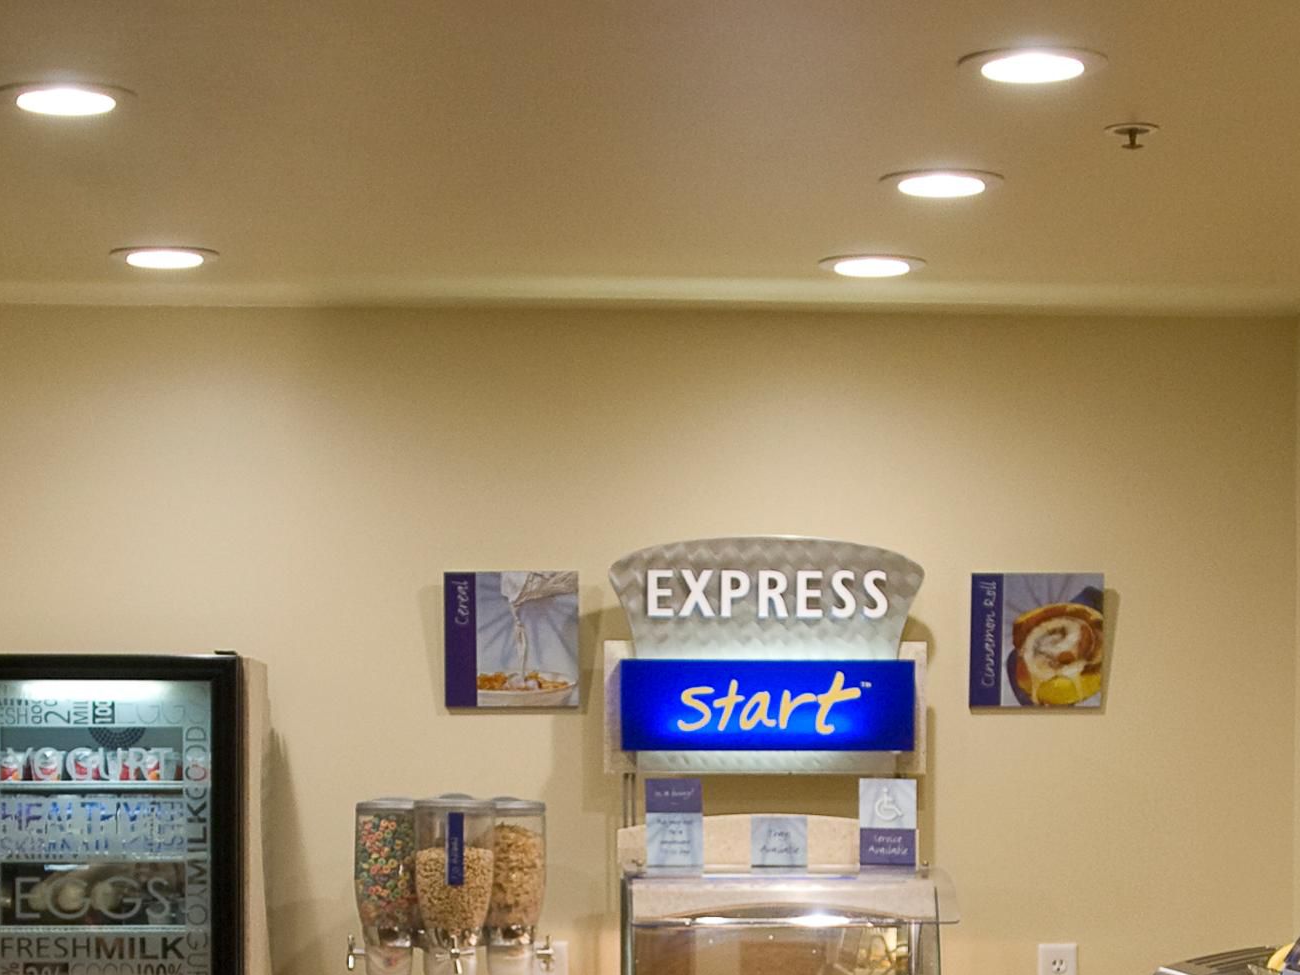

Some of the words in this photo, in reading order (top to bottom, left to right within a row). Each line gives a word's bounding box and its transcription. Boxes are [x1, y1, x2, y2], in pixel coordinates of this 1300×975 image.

[452, 580, 470, 625] Cereal
[646, 568, 890, 620] EXPRESS
[980, 581, 997, 607] Roll
[981, 611, 996, 687] Cinnamon
[677, 670, 862, 735] start
[4, 746, 174, 782] YOGURT
[186, 801, 208, 887] MILK
[868, 845, 909, 856] Available
[14, 875, 171, 920] EGGS
[1, 936, 90, 958] FRESH
[94, 936, 186, 960] MILK
